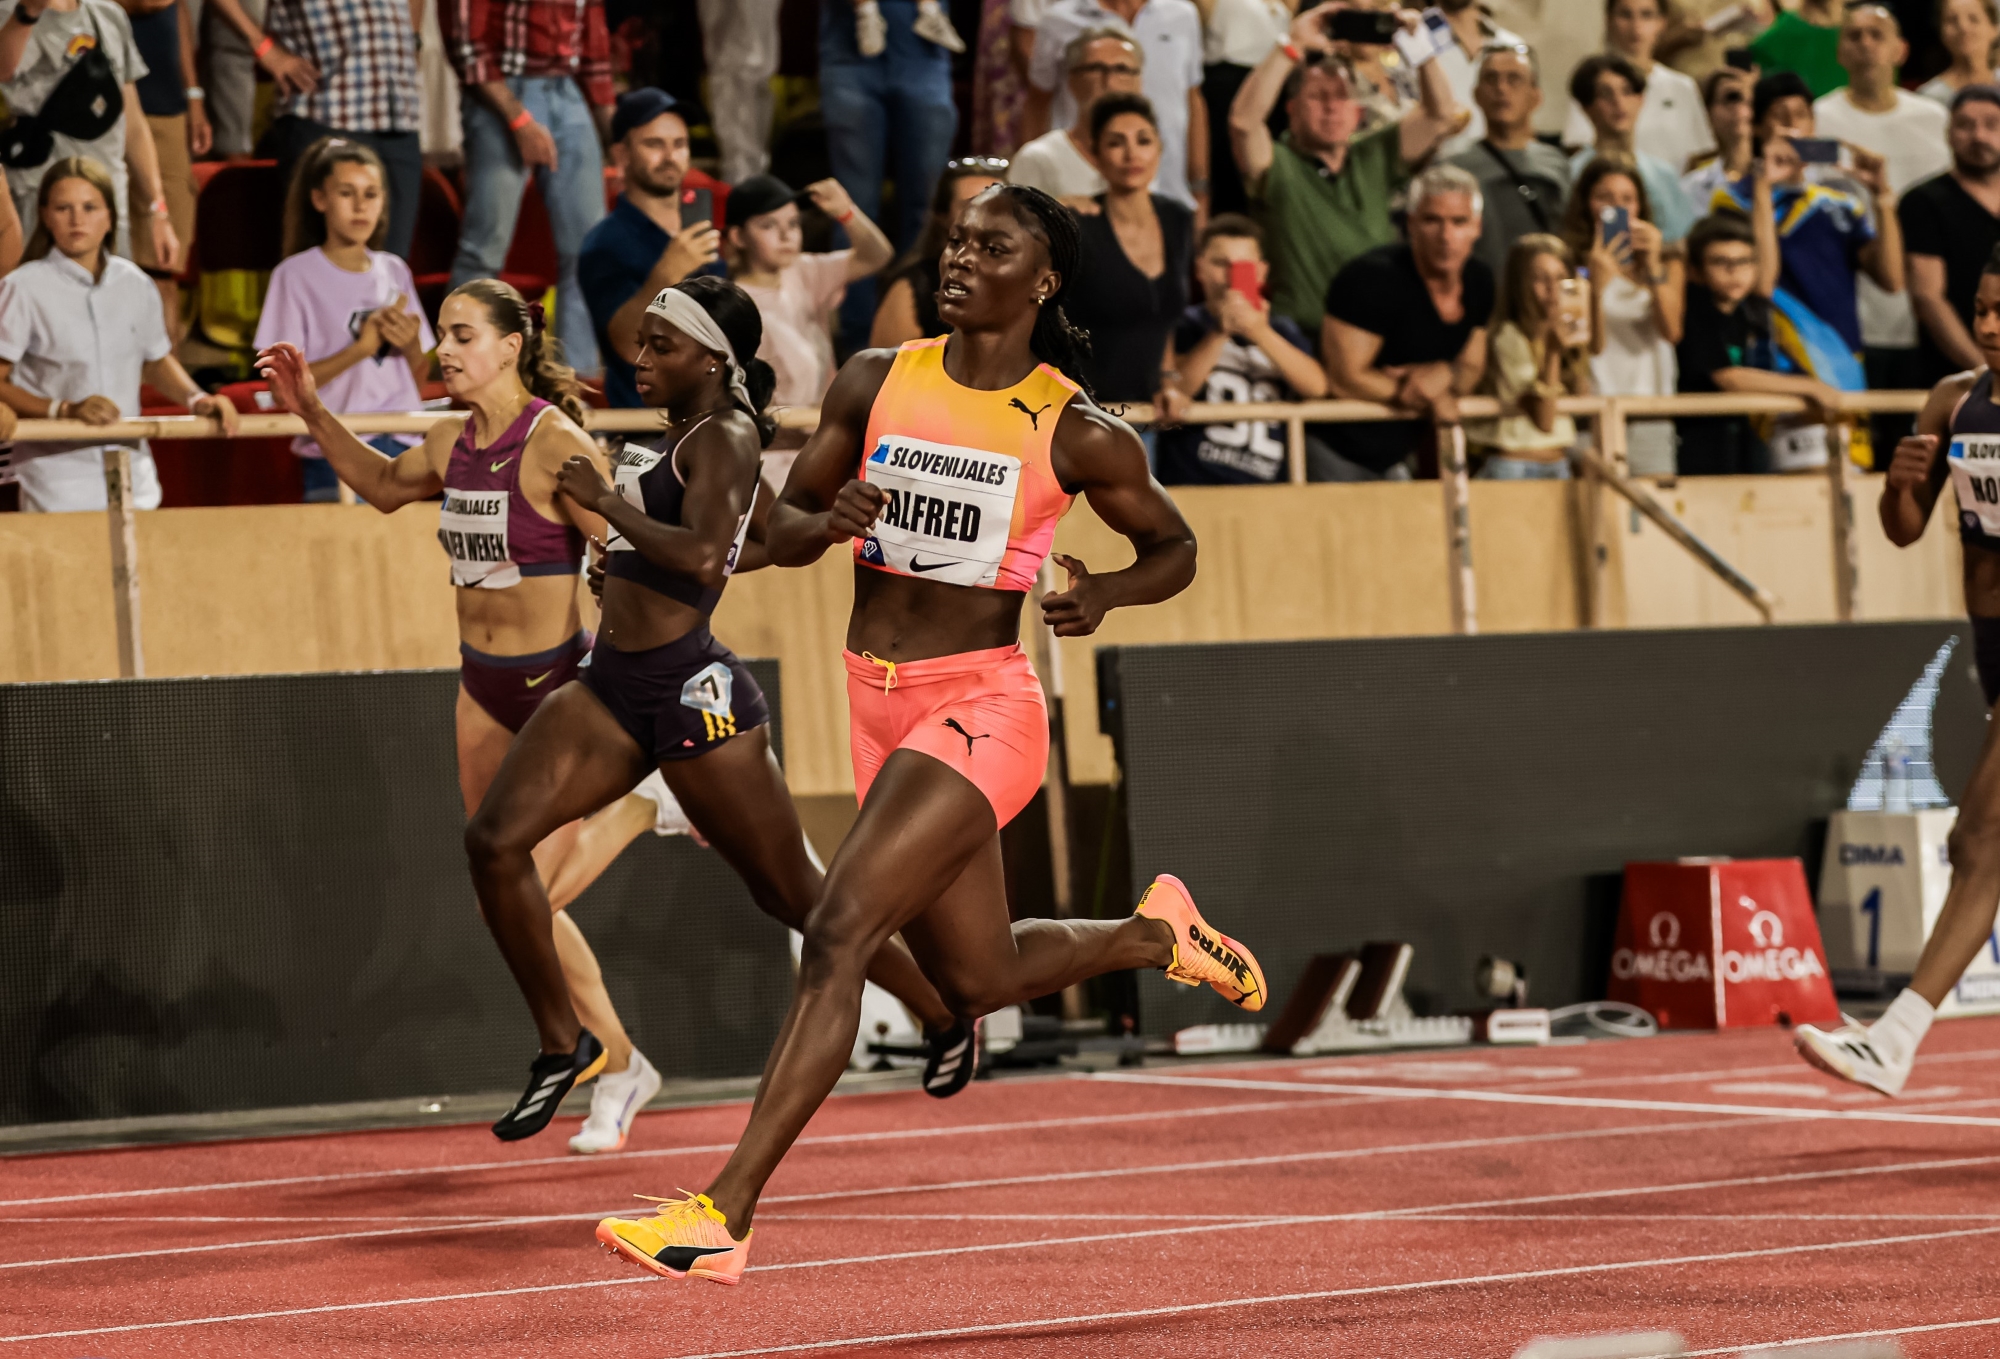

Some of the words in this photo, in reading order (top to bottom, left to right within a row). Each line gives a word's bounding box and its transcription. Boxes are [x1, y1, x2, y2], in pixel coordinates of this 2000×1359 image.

[890, 446, 1007, 485] SLOVENIJALES
[885, 488, 981, 543] ALFRED
[700, 674, 720, 701] 7
[1840, 843, 1904, 866] DIMA
[1860, 886, 1882, 968] 1
[1189, 924, 1248, 987] NITRO
[1612, 948, 1713, 982] OMEGA
[1723, 947, 1826, 983] OMEGA
